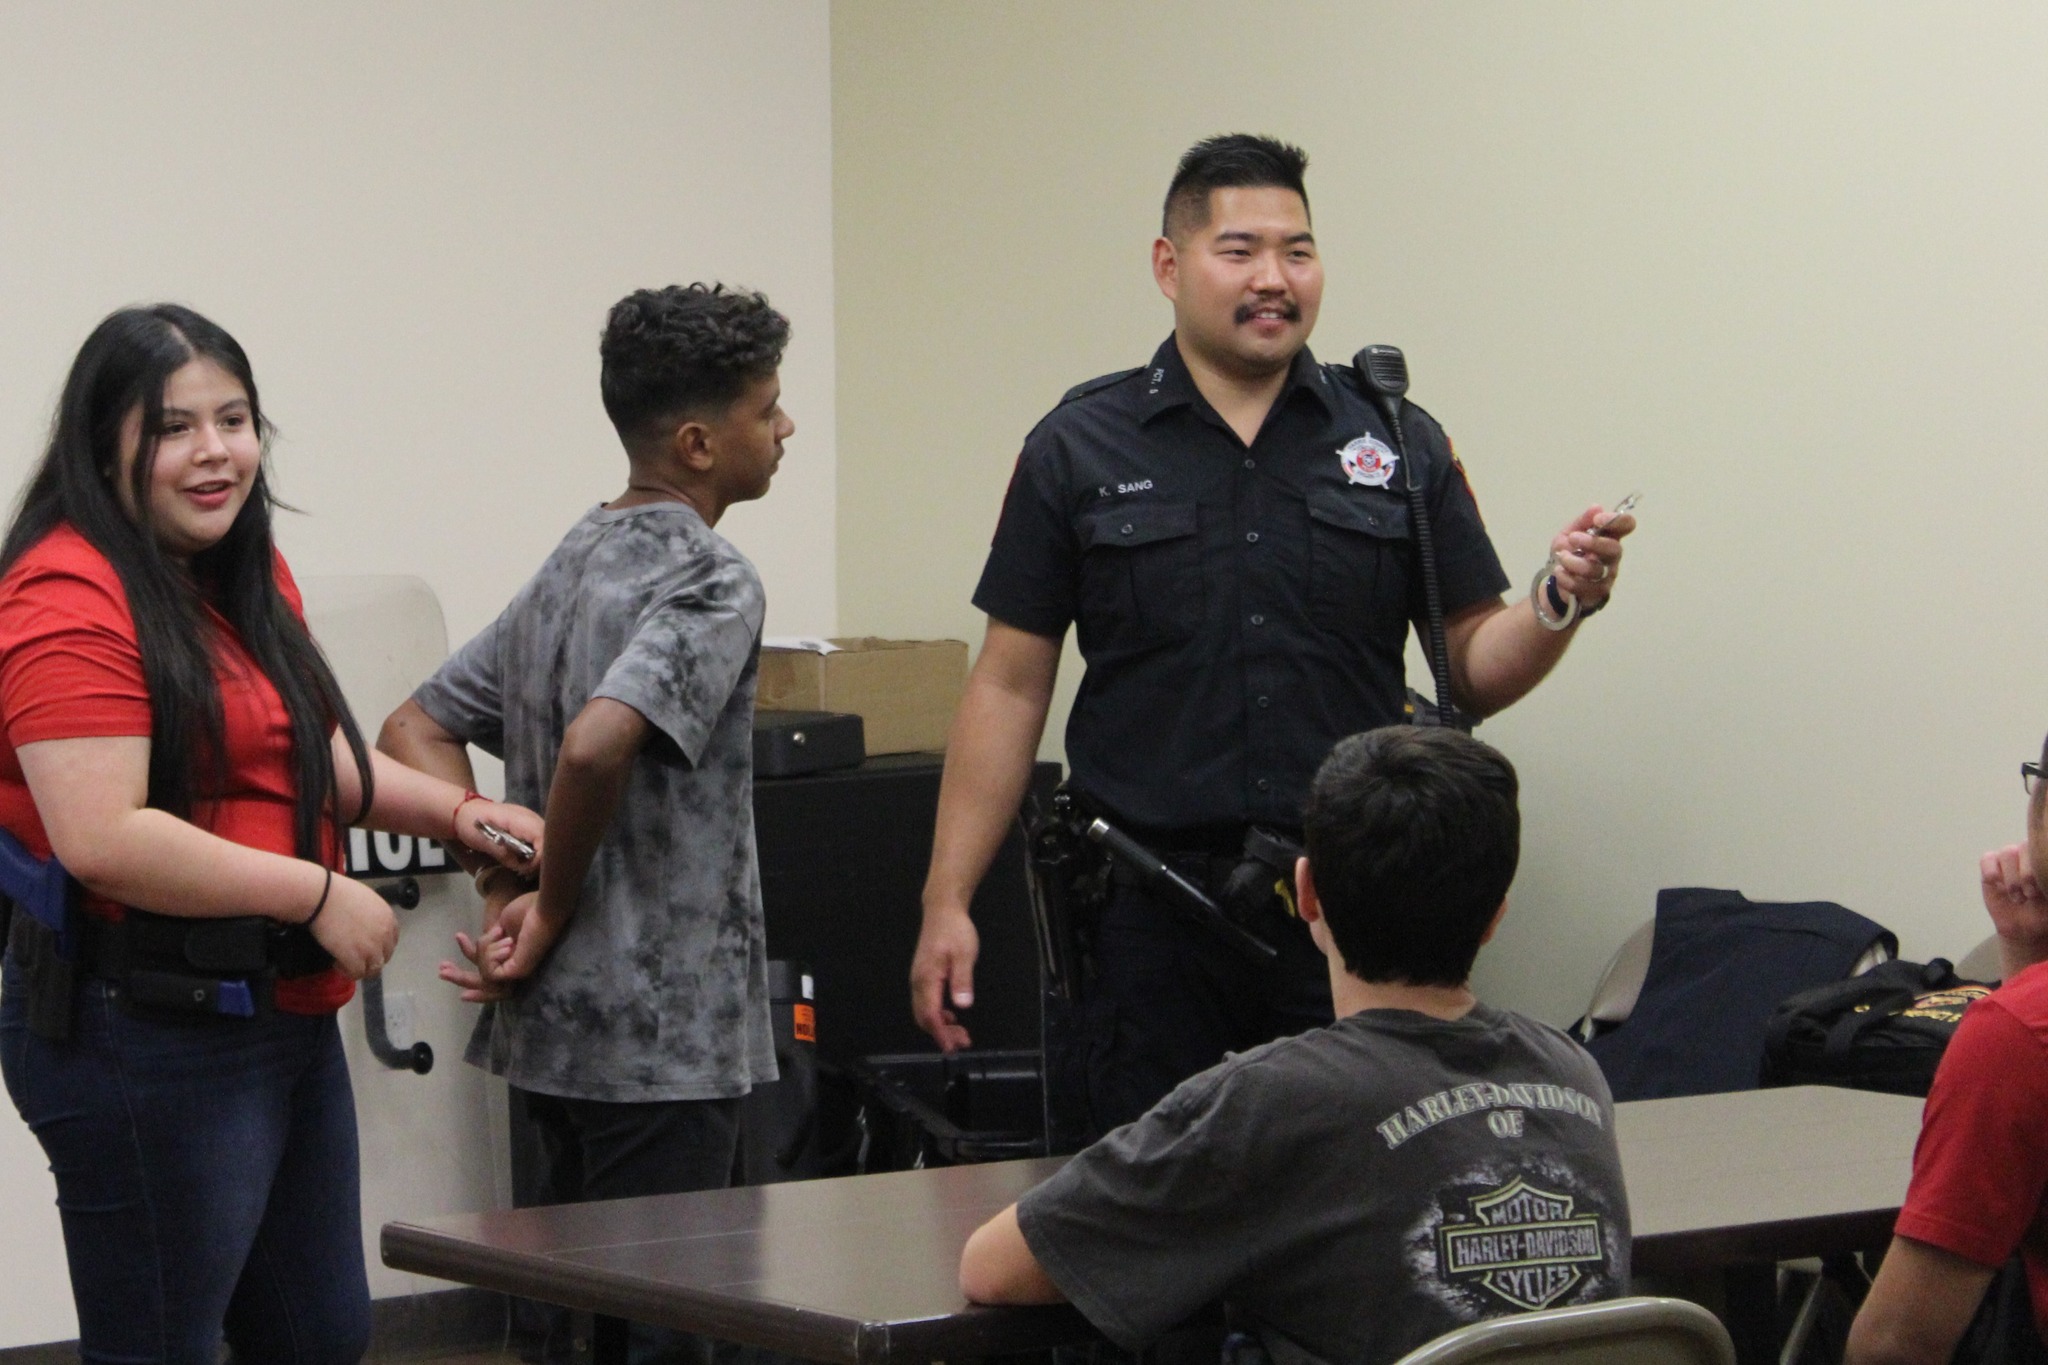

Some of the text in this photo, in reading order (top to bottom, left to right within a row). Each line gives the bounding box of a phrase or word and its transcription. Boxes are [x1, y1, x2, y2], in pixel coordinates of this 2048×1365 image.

[1099, 479, 1153, 497] K. SANG
[1488, 1110, 1524, 1138] OF
[1491, 1192, 1563, 1225] MOTOR
[1456, 1226, 1596, 1266] HARLEY-DAVIDSON
[1497, 1265, 1570, 1304] CYCLES
